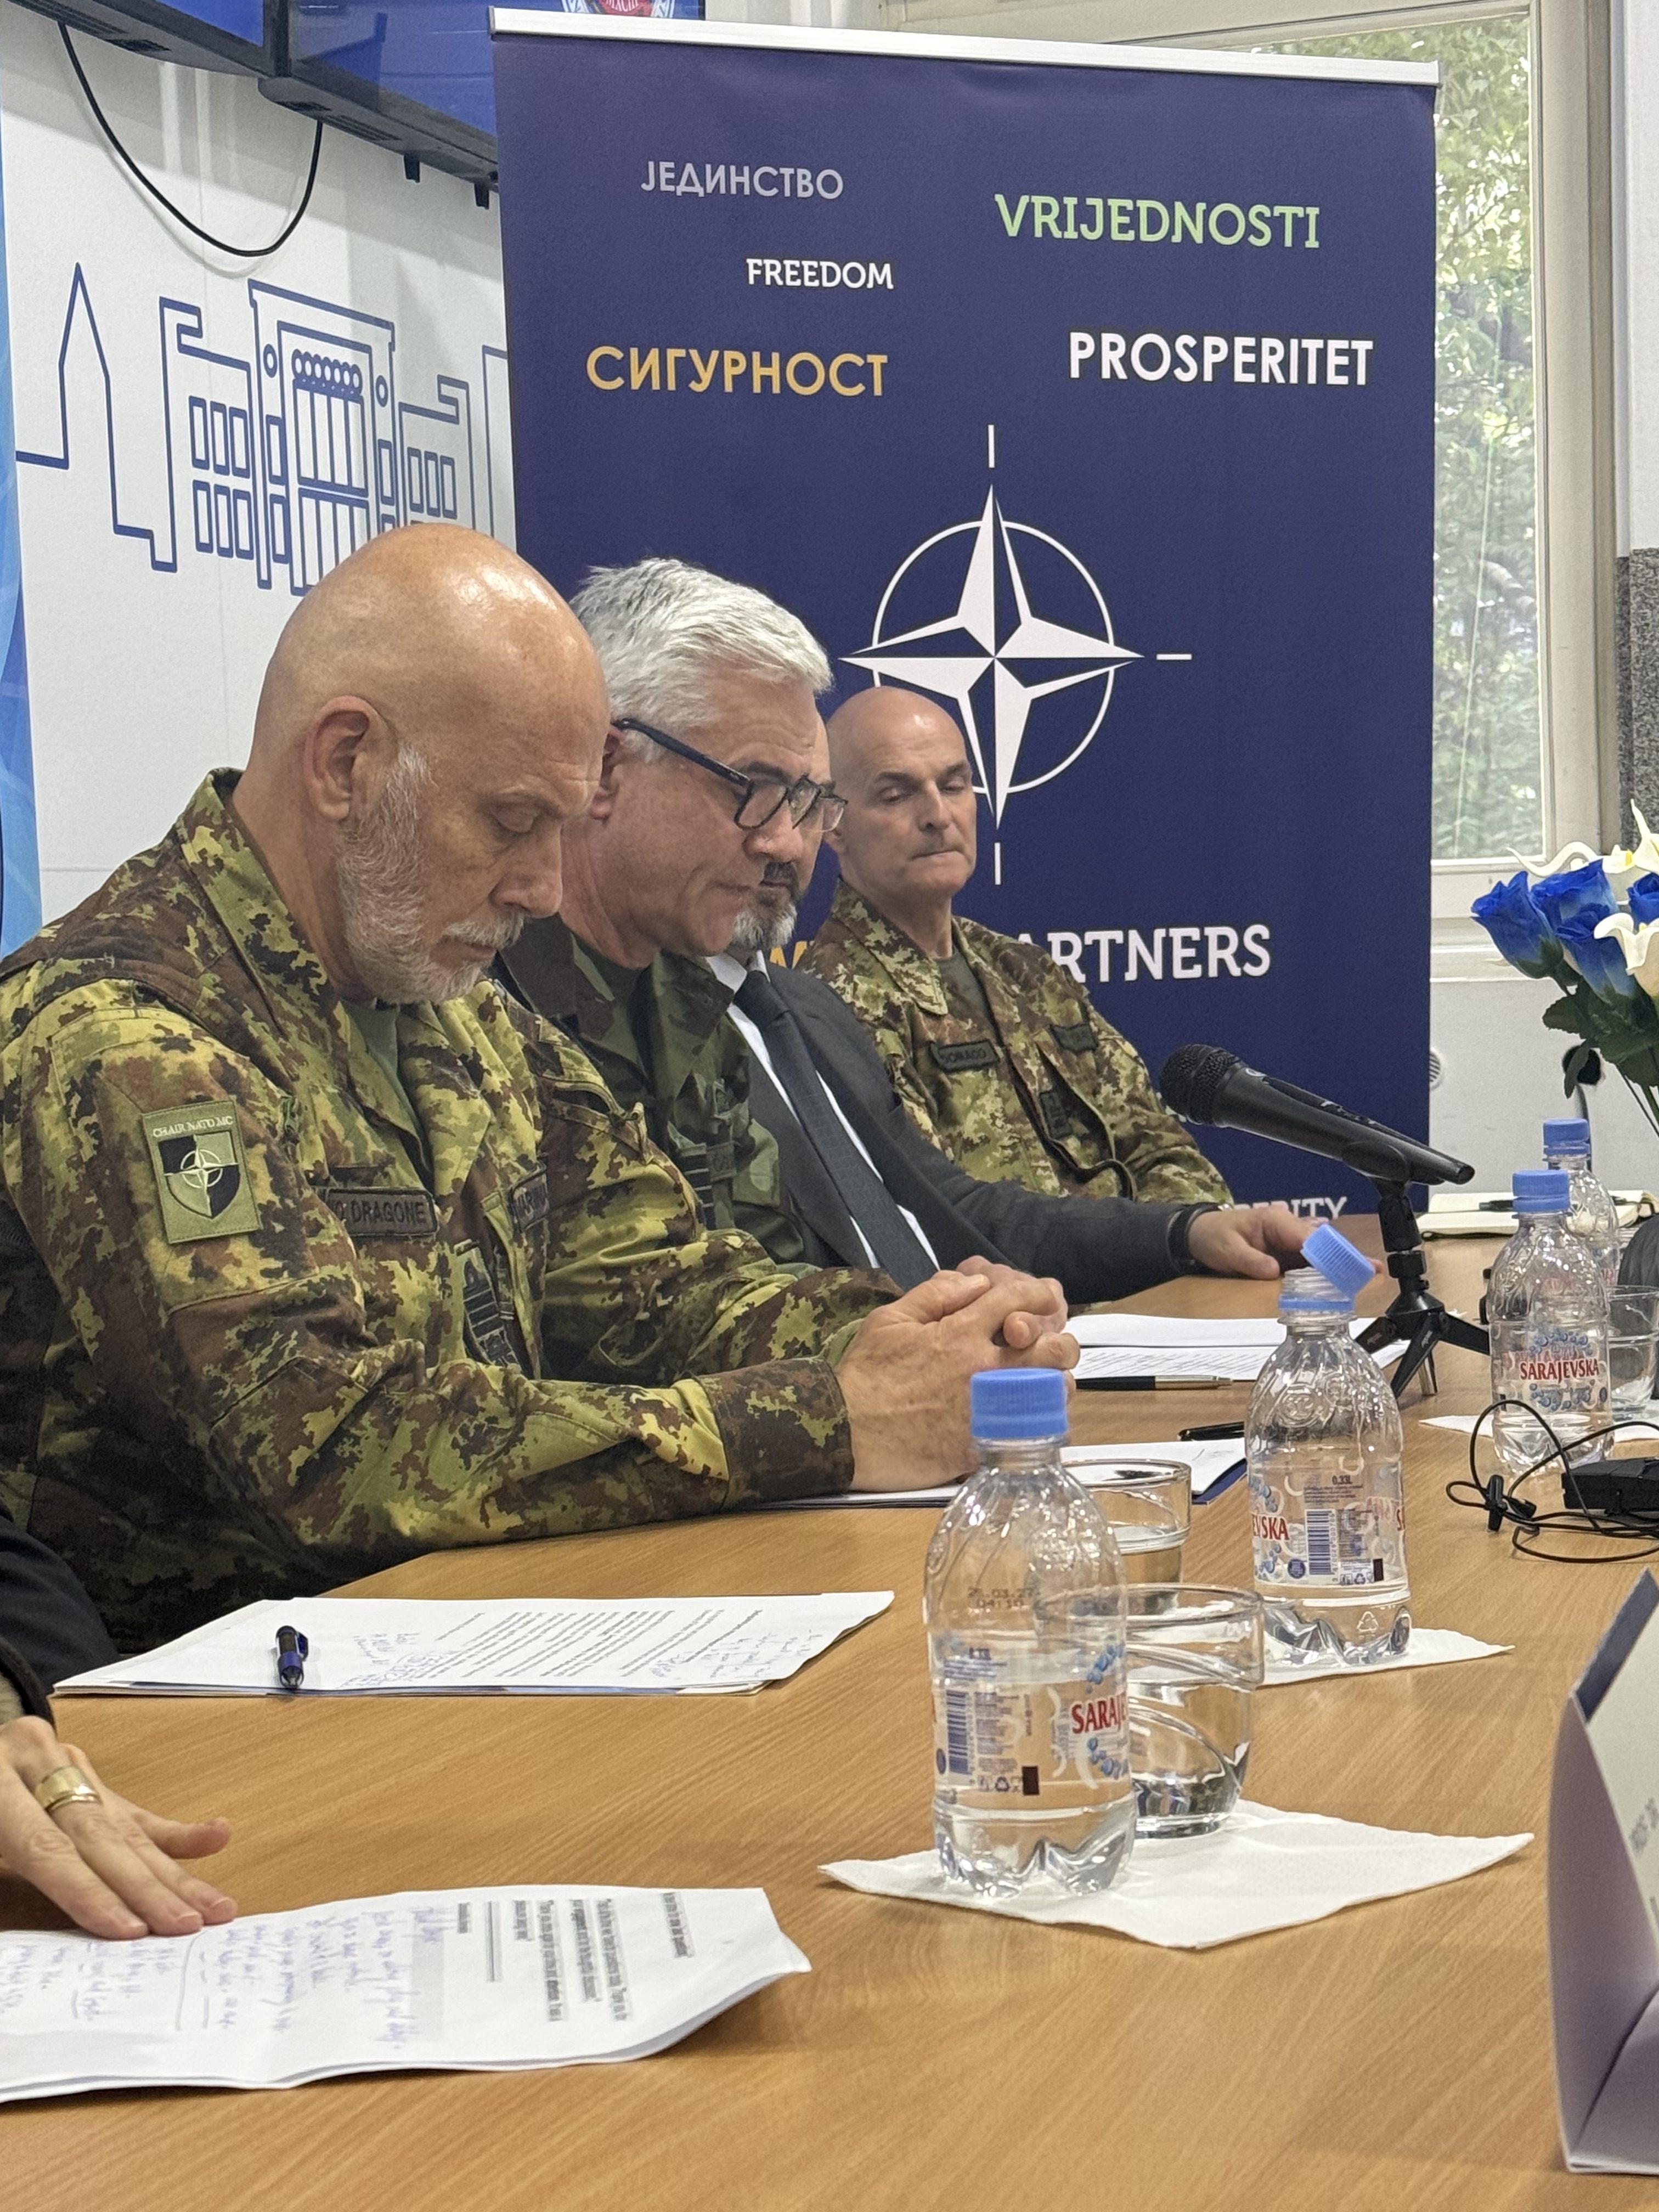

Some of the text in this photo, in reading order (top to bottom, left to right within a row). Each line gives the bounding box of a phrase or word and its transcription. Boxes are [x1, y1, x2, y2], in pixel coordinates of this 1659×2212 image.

[641, 161, 844, 199] ЈЕДИНСТВО
[994, 194, 1321, 249] VRIJEDNOSTI
[746, 258, 894, 290] FREEDOM
[586, 346, 888, 396] СИГУРНОСТ
[1070, 331, 1374, 386] PROSPERITET
[1018, 924, 1271, 983] RTNERS
[153, 1116, 233, 1137] CHAIR NATO MC
[351, 1199, 427, 1224] DRAGONE
[1520, 1358, 1600, 1383] SARAJEVSKA
